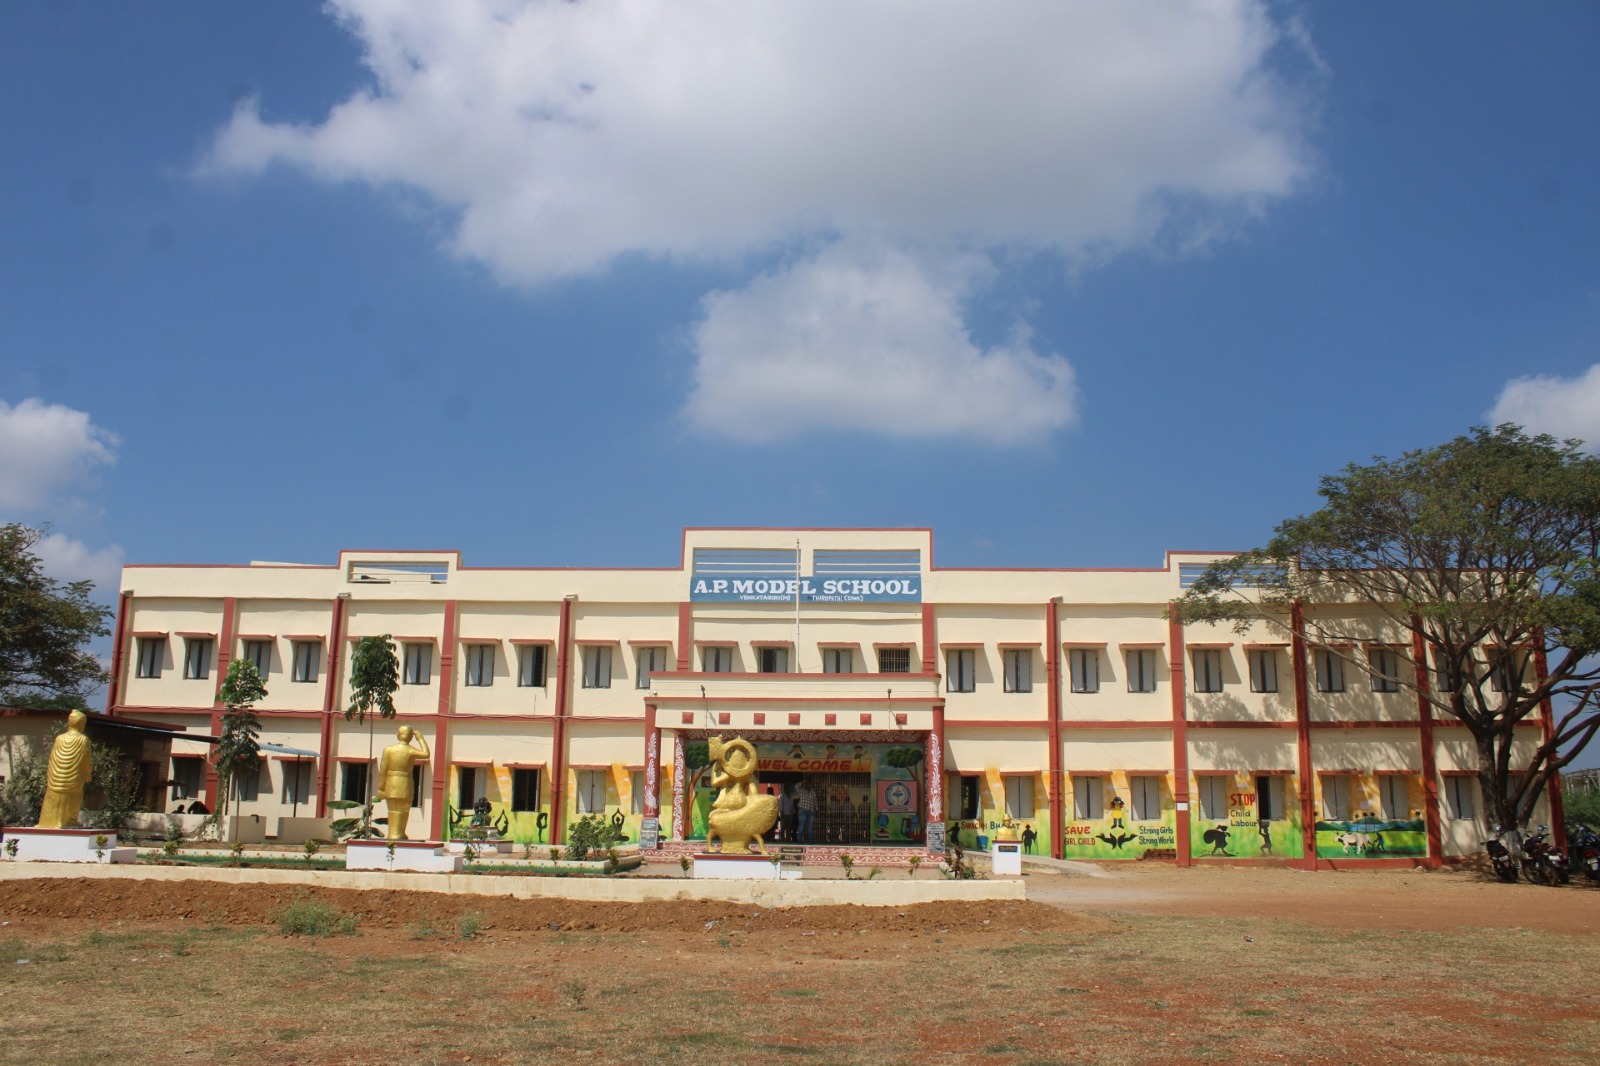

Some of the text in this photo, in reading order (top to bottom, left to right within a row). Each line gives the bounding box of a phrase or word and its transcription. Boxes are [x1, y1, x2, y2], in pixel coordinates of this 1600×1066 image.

[693, 579, 918, 595] A.P. MODEL SCHOOL
[797, 760, 853, 771] COME
[1230, 793, 1256, 807] STOP
[1230, 809, 1251, 818] Child
[990, 821, 1021, 830] BHAT
[1230, 819, 1258, 827] Labour
[1064, 826, 1091, 835] SAVE
[1139, 825, 1174, 835] Strong Girls
[1078, 837, 1096, 846] CHILD
[1139, 835, 1175, 847] Strong World
